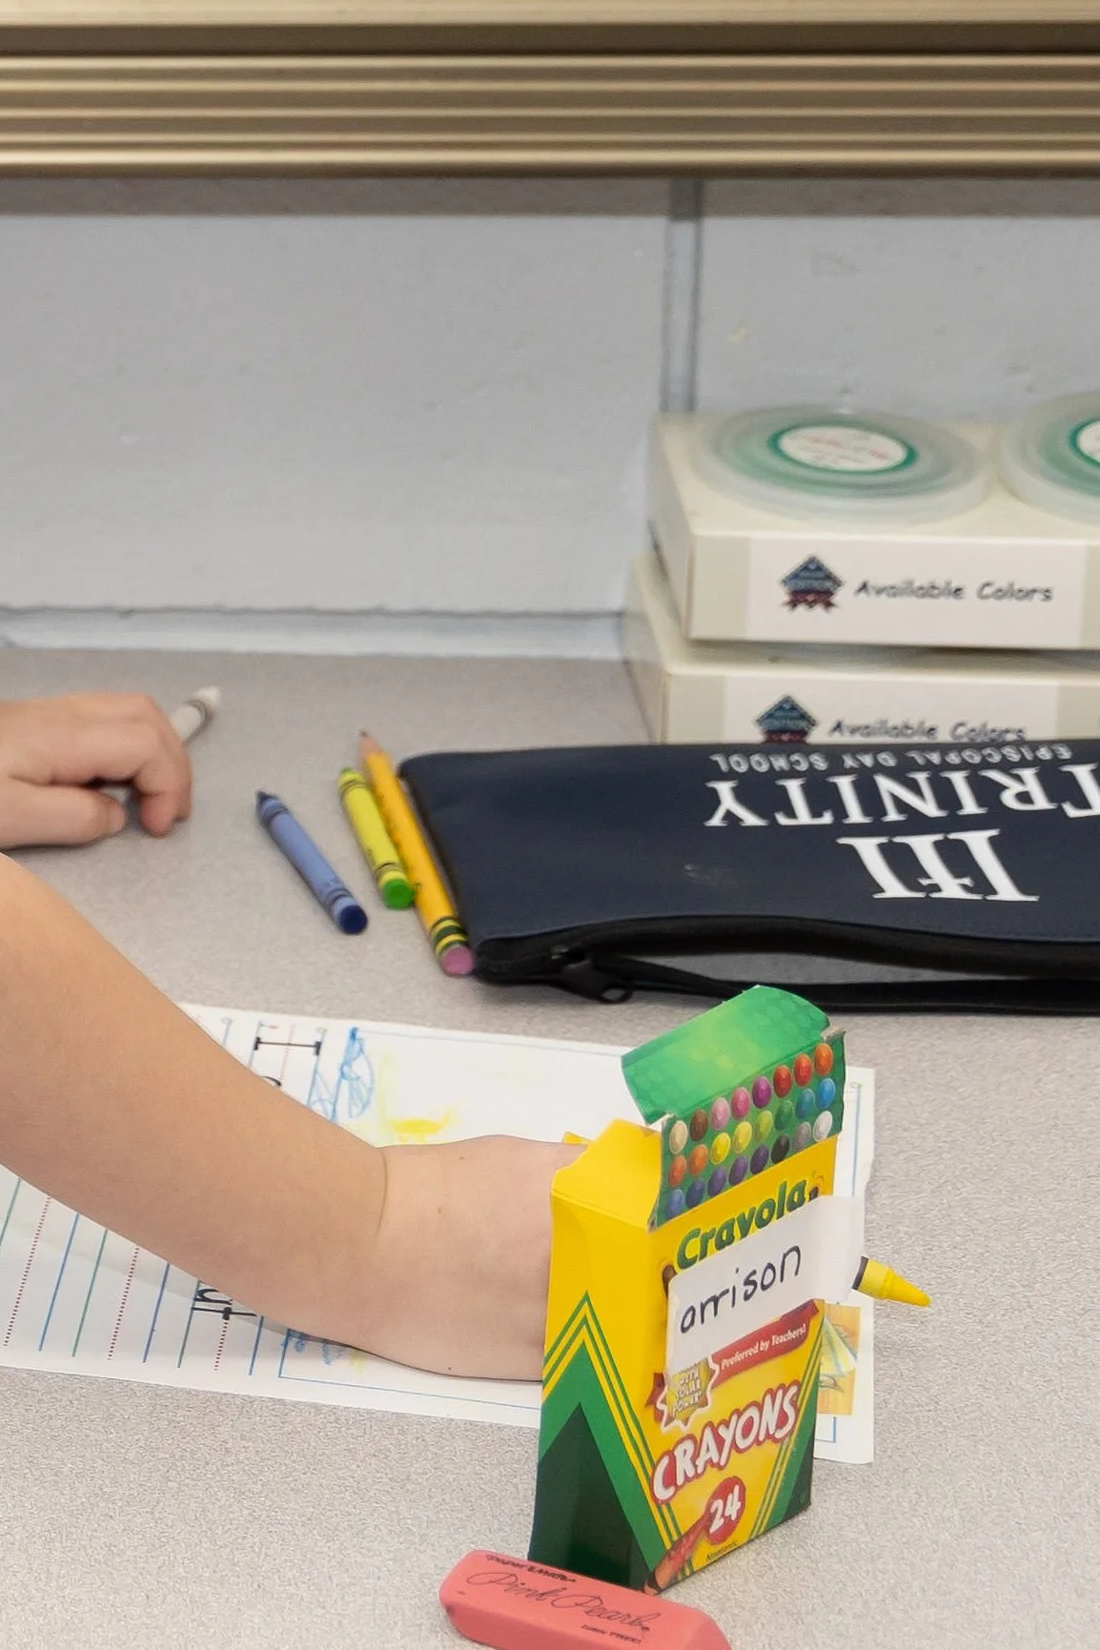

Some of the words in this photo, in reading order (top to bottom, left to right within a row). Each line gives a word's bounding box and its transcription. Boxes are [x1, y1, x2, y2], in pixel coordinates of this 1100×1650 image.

[854, 579, 965, 600] Available
[976, 581, 1054, 601] Colors
[829, 720, 938, 739] Available
[949, 722, 1027, 741] Colors
[710, 752, 831, 773] SCHOOL
[842, 751, 899, 769] DAY
[904, 743, 1074, 767] EPISCOPAL
[704, 762, 1100, 827] TRINITY
[676, 1179, 807, 1270] Crayola
[720, 1342, 759, 1370] Preferred
[760, 1340, 771, 1352] by
[652, 1384, 799, 1502] CRAYONS
[708, 1483, 742, 1535] 24
[467, 1572, 568, 1602] Pink
